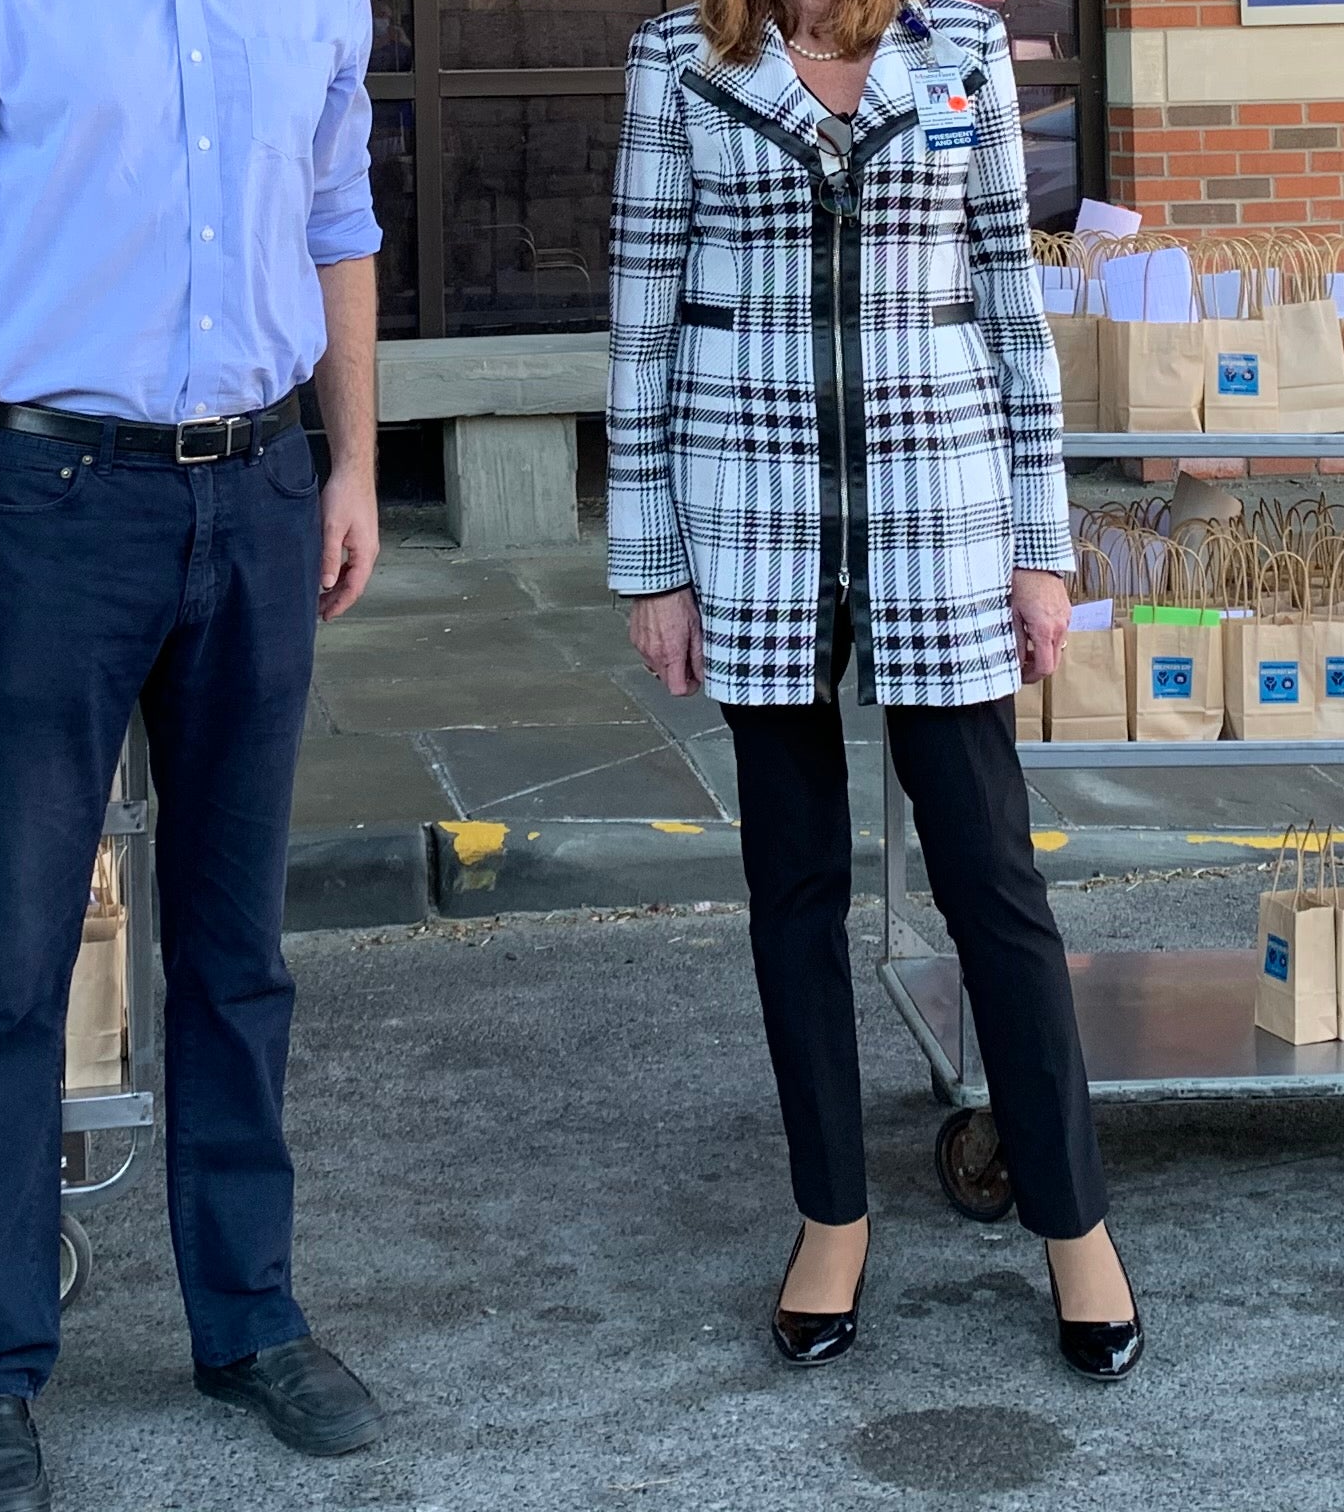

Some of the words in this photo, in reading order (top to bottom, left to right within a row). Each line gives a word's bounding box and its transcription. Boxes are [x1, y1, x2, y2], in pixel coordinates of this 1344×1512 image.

[928, 130, 974, 142] PRESIDENT
[934, 139, 953, 148] AND
[953, 136, 972, 146] CEO
